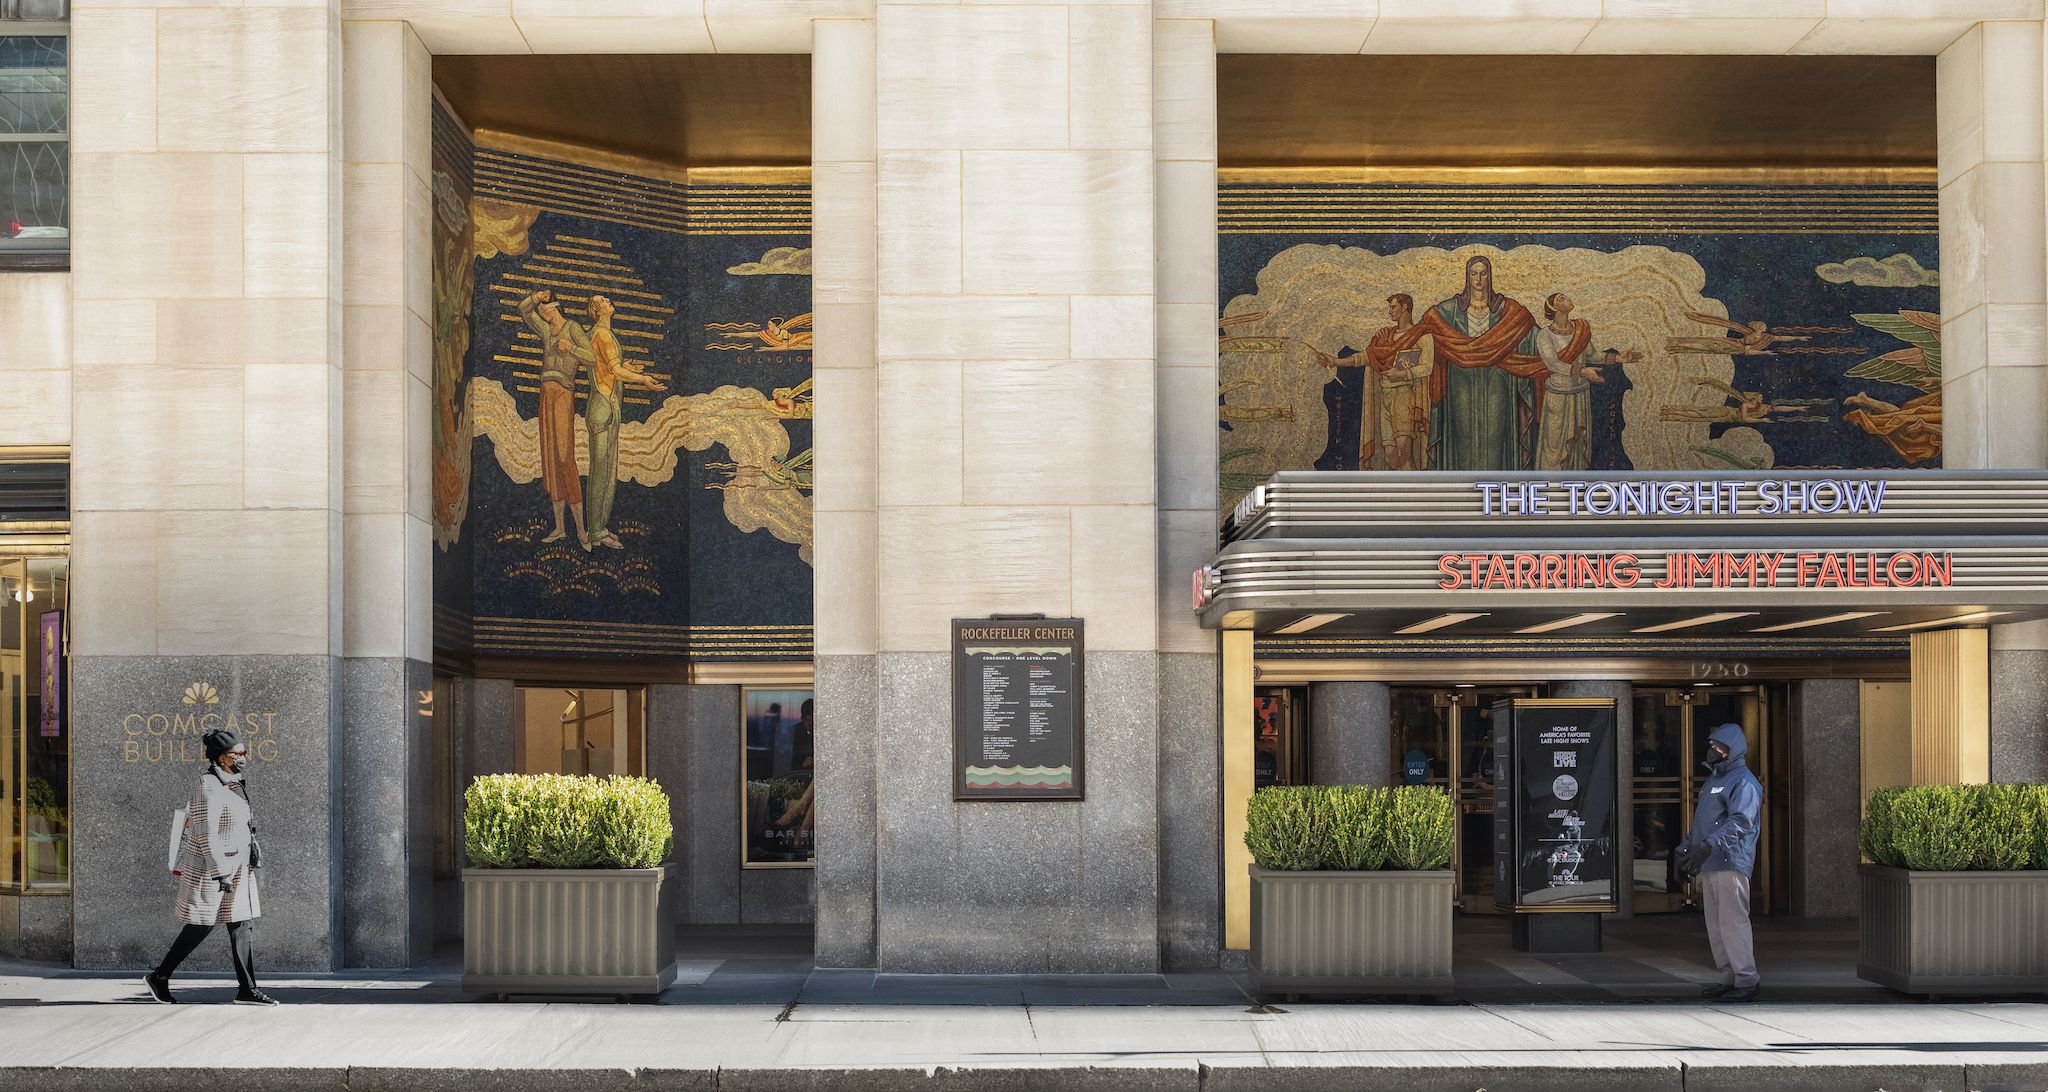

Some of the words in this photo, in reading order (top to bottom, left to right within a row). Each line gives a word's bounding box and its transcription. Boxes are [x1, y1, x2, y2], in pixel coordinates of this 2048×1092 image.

[1475, 480, 1550, 515] THE
[1562, 480, 1746, 515] TONIGHT
[1757, 478, 1887, 515] SHOW
[1438, 552, 1642, 590] STARRING
[1654, 552, 1786, 588] JIMMY
[1797, 551, 1952, 588] FALLON
[961, 627, 1030, 640] ROCKEFELLER
[1034, 627, 1075, 640] CENTER
[1691, 662, 1748, 679] 1250
[123, 712, 278, 736] COMCAST
[1553, 759, 1577, 768] LIVE
[1256, 768, 1273, 776] ONLY
[1408, 768, 1425, 776] ONLY
[765, 830, 795, 838] BAR
